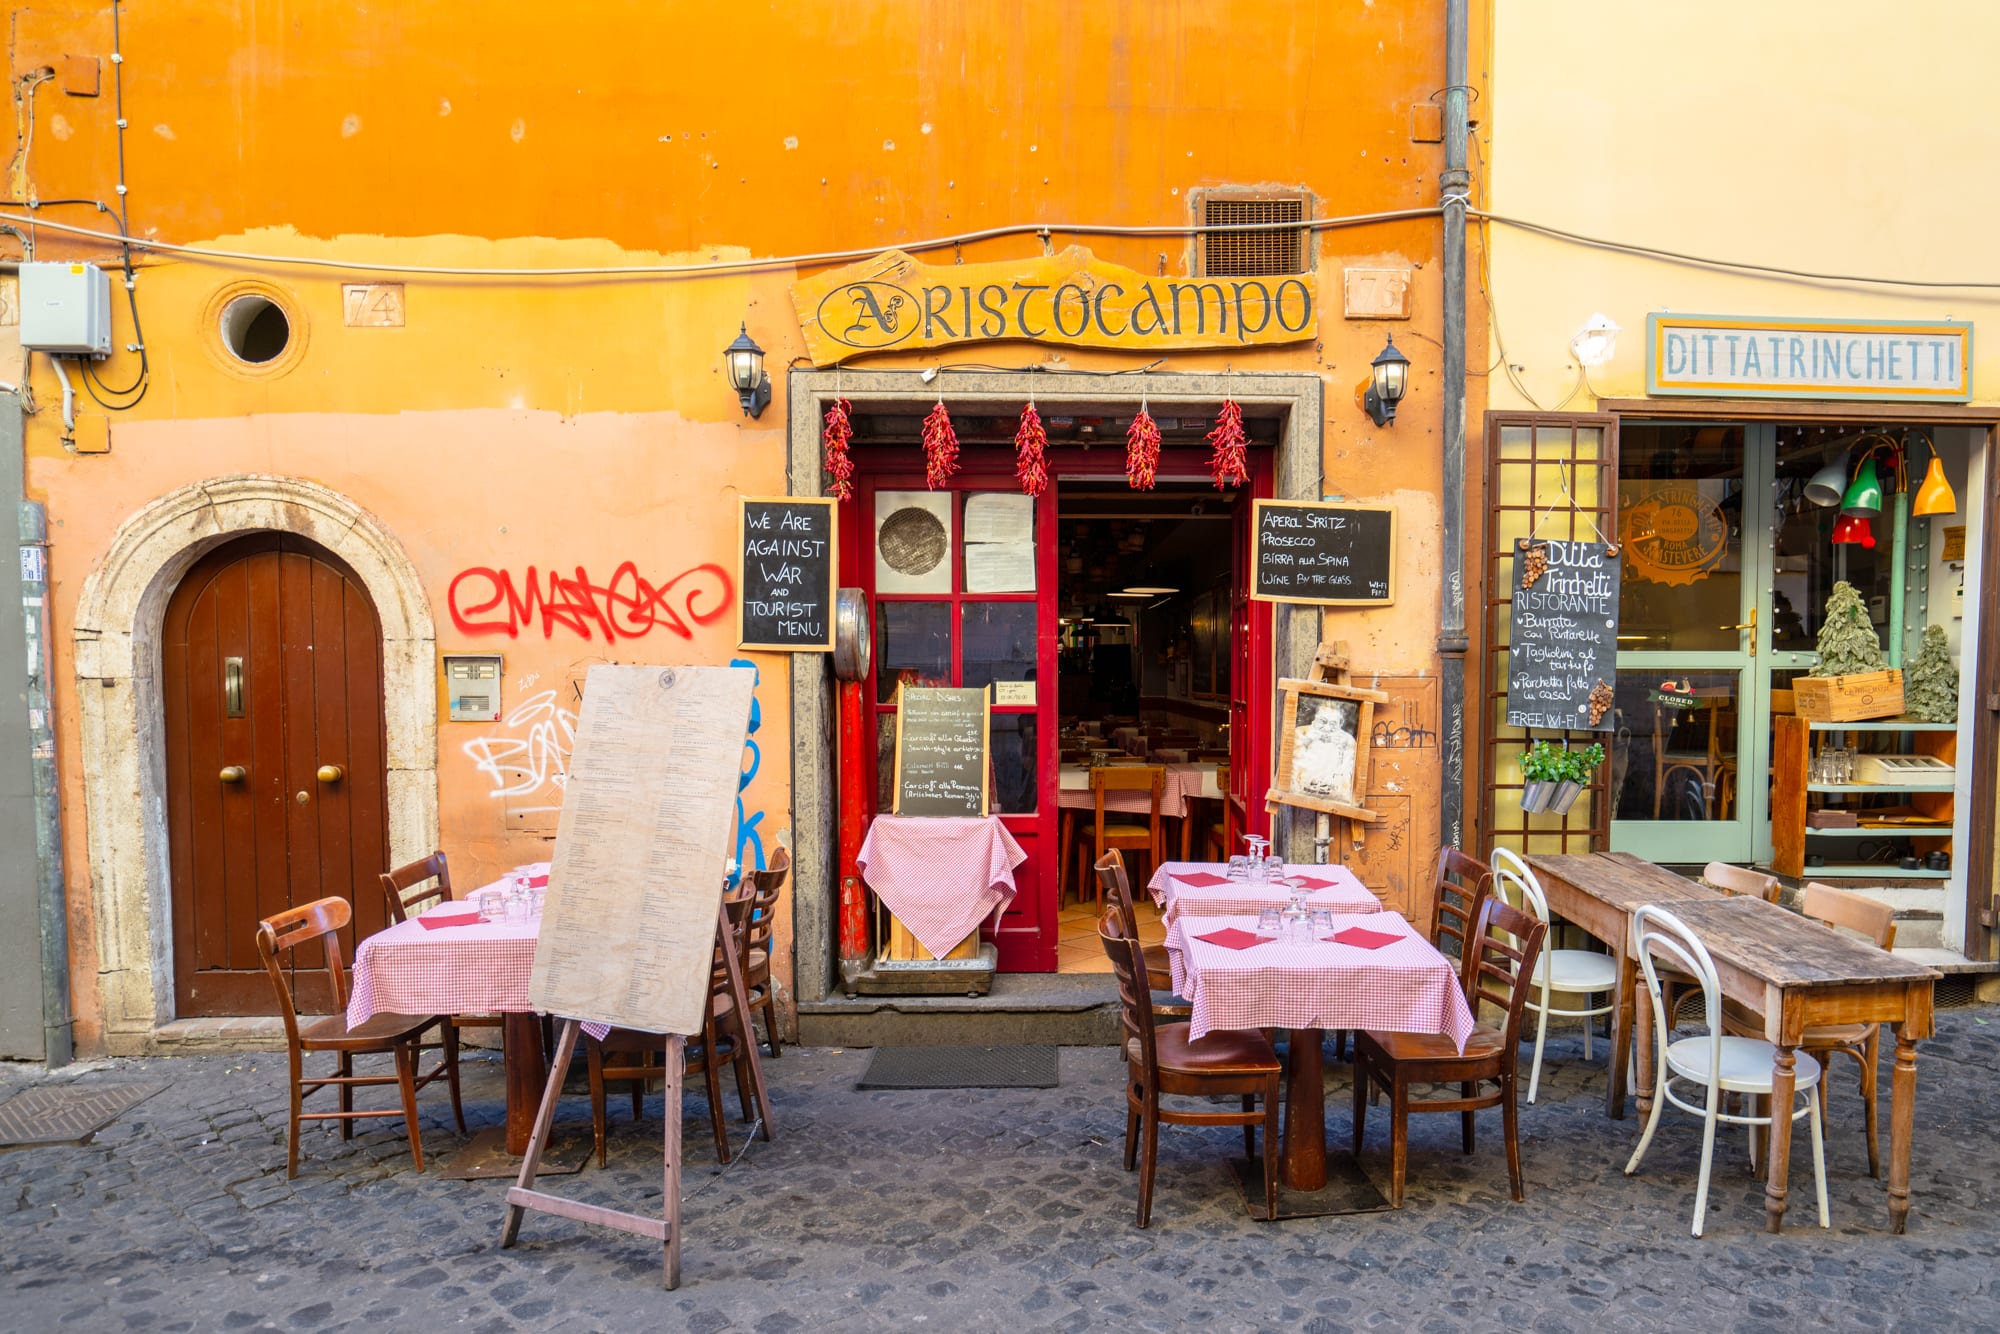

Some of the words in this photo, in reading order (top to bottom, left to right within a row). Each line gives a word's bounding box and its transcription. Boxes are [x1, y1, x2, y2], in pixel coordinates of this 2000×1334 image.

[350, 289, 394, 321] 74
[844, 279, 1312, 343] ARISTOCAMPO
[1668, 333, 1955, 382] DITTATRINCHETTI
[747, 512, 771, 530] WE
[781, 510, 812, 530] ARE
[1262, 511, 1303, 529] APEROL
[1672, 508, 1682, 518] 76
[1261, 531, 1316, 547] PROSECCO
[746, 539, 825, 558] AGAINST
[1547, 540, 1603, 568] Ditta
[760, 562, 802, 585] WAR
[1544, 568, 1612, 597] Trinchetti
[770, 588, 789, 597] AND
[745, 601, 817, 617] TOURIST
[1515, 591, 1610, 615] RISTORANTE
[778, 621, 823, 638] MENU.
[1522, 612, 1578, 629] Burrata
[1520, 642, 1574, 662] Tagliolini
[1517, 672, 1563, 689] Porchetta
[1539, 691, 1572, 701] casa
[1658, 694, 1693, 705] CLOSED
[1509, 711, 1544, 728] FREE
